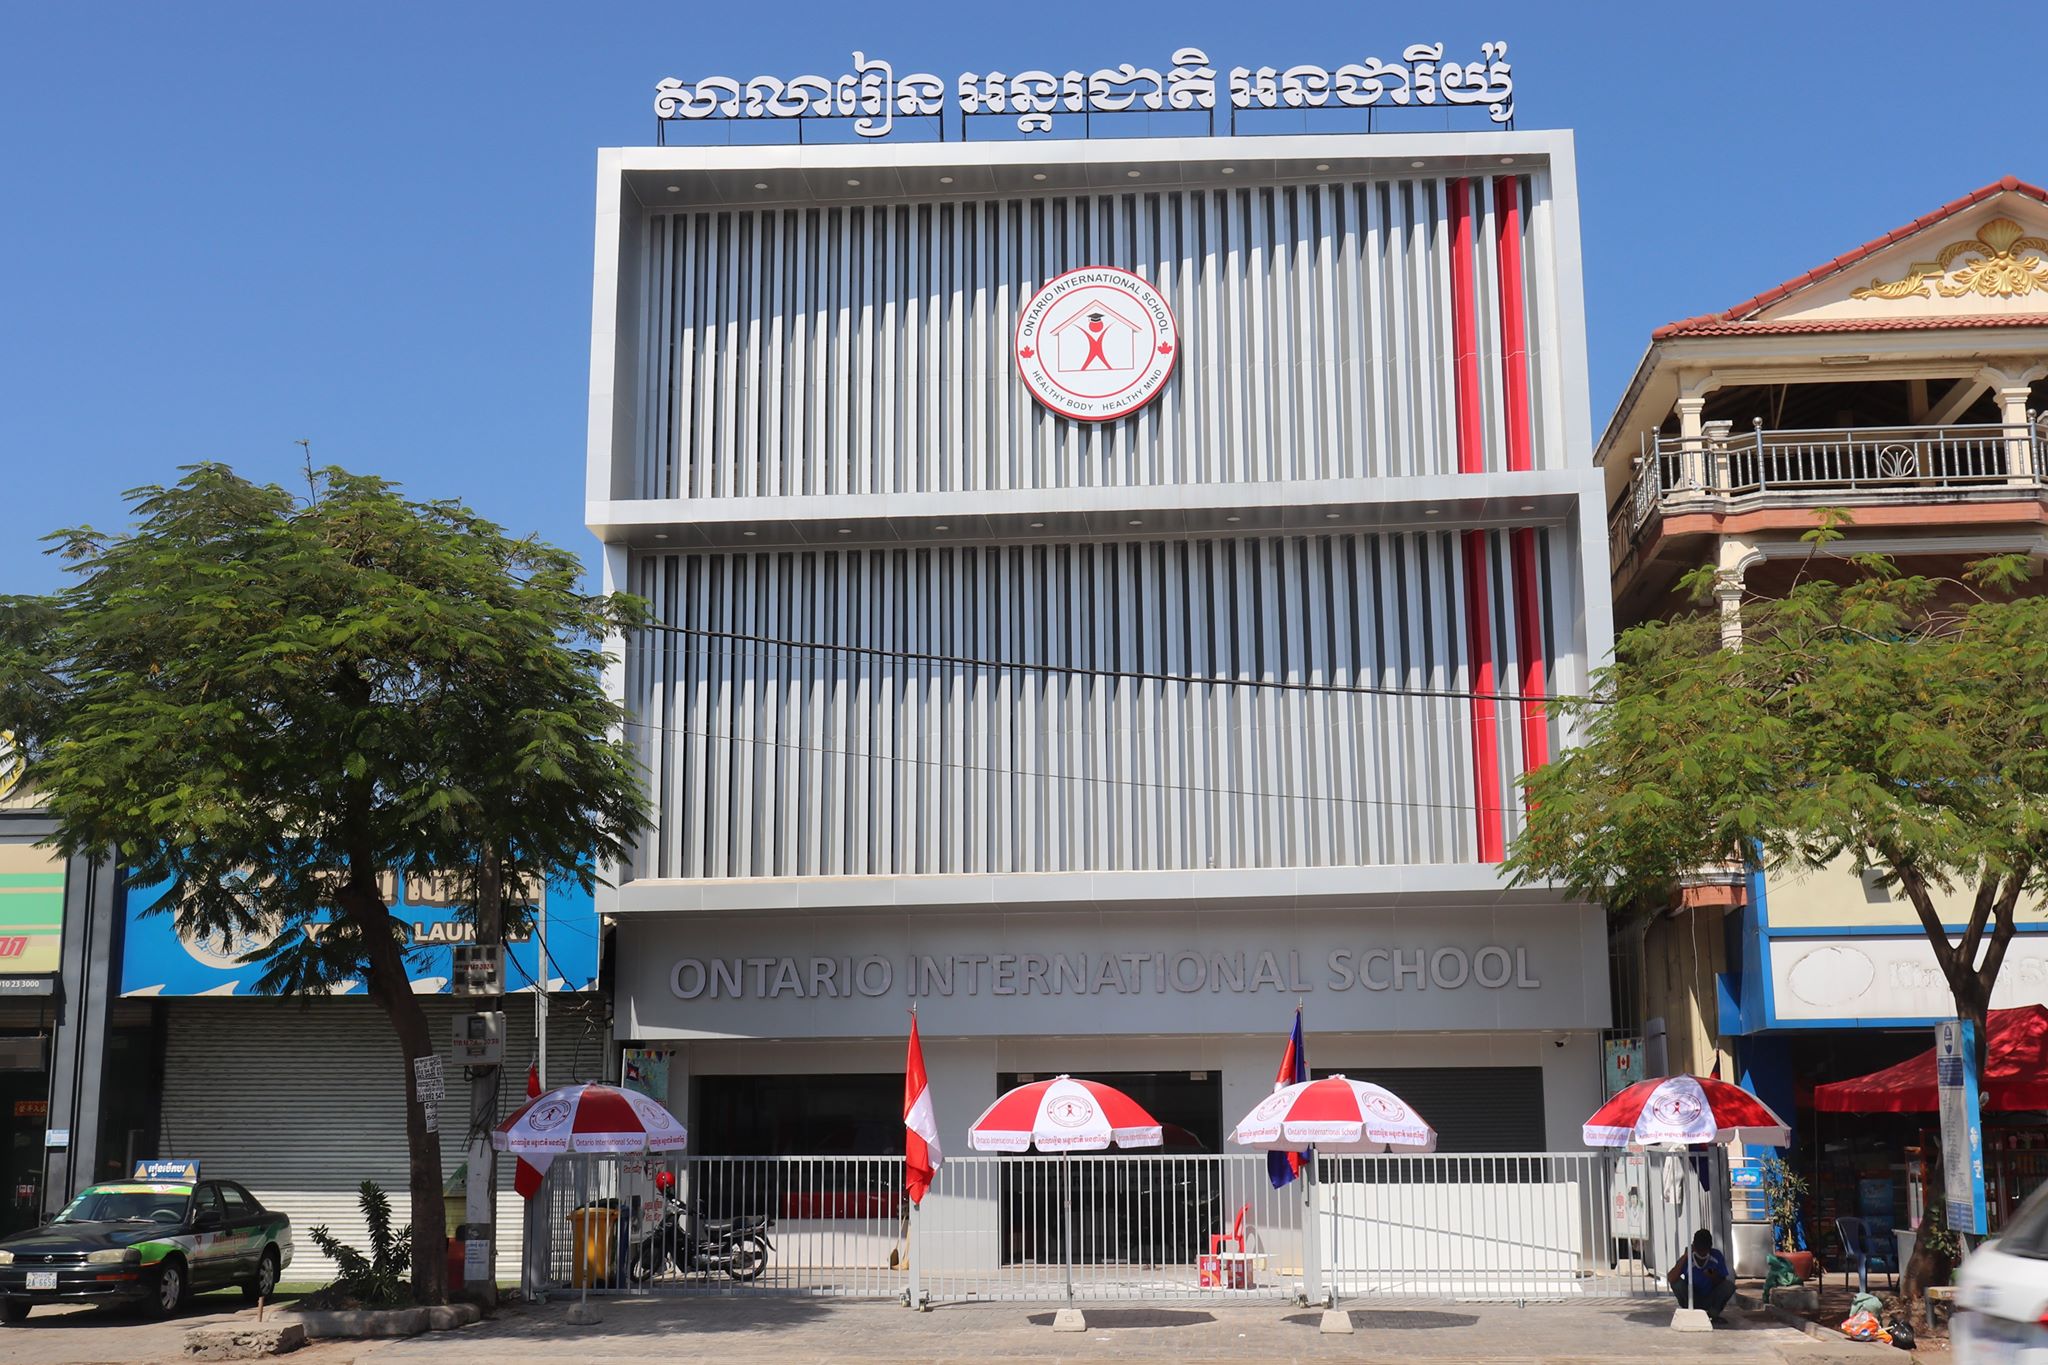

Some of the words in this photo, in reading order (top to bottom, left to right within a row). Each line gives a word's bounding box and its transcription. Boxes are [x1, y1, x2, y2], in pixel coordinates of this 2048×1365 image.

[654, 50, 945, 137] សាលារៀន
[958, 47, 1217, 133] អន្តរជាតិ
[1024, 292, 1054, 337] ONTARIO
[1054, 273, 1140, 296] INTERNATIONAL
[1141, 292, 1169, 335] SCHOOL
[1032, 370, 1065, 402] HEALTHY
[1066, 399, 1094, 412] BODY
[1102, 389, 1143, 412] HEALTHY
[1143, 369, 1162, 391] MIND
[21, 980, 39, 988] 3000
[669, 953, 894, 999] ONTARIO
[906, 949, 1314, 998] INTERNATIONAL
[1327, 946, 1541, 992] SCHOOL
